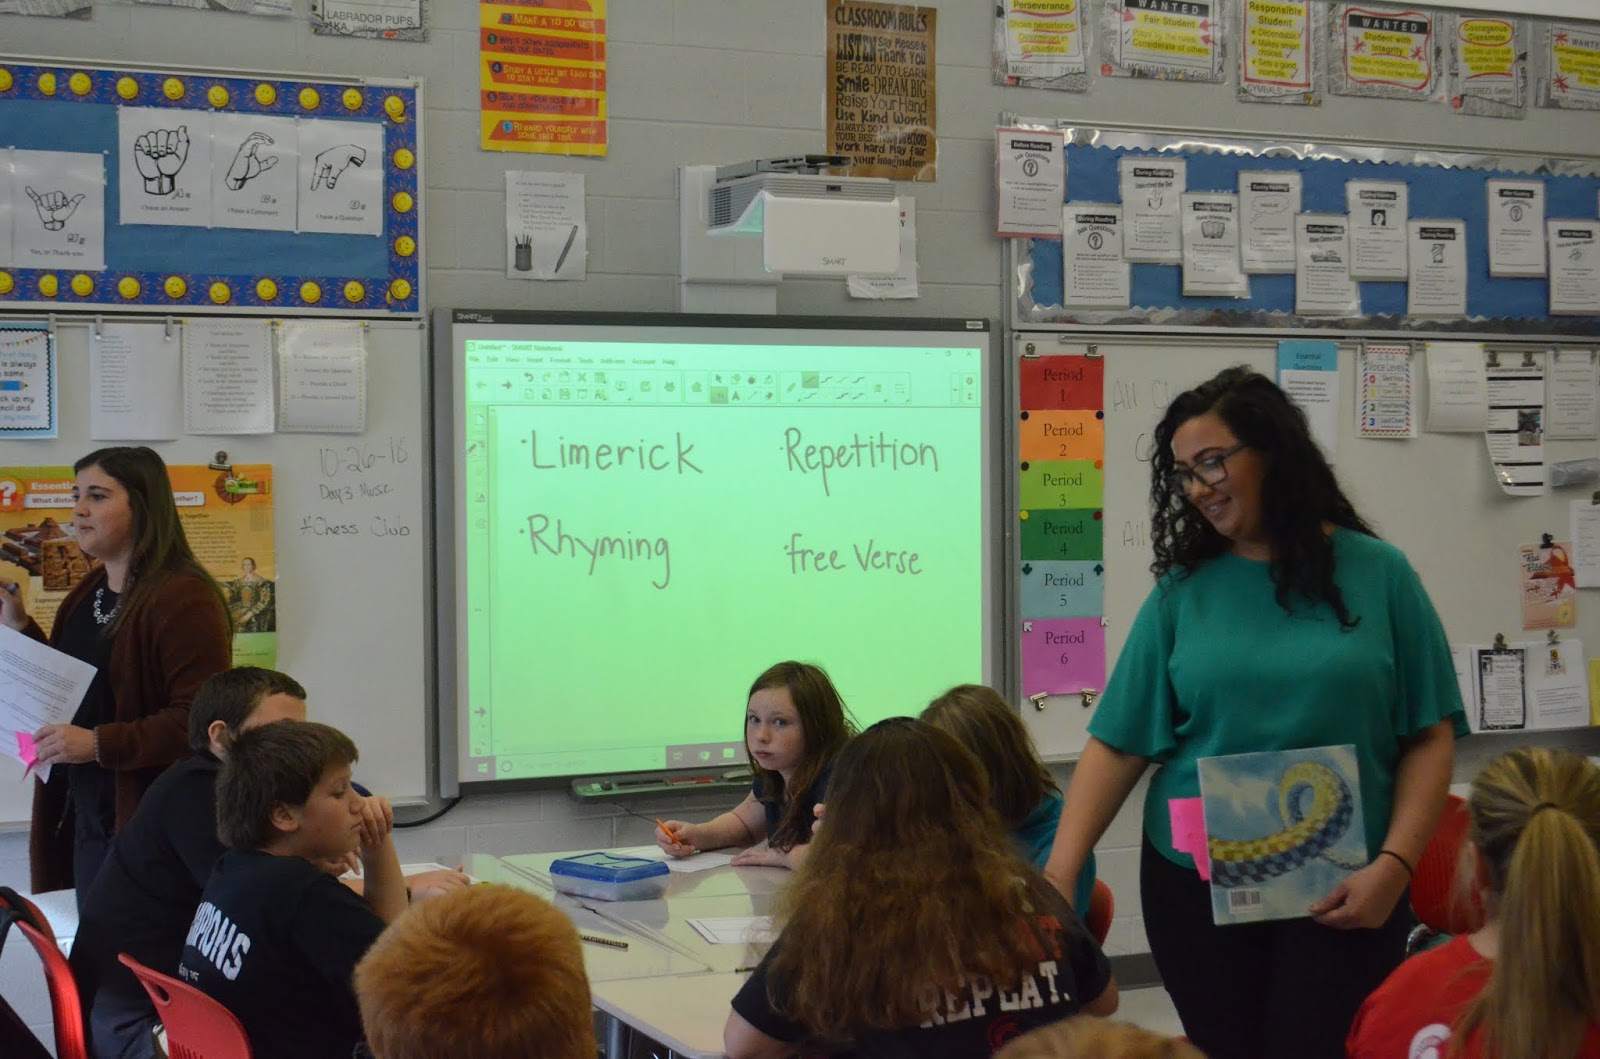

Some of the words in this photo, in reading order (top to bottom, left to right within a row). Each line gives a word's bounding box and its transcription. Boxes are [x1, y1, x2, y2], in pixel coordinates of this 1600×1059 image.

[1013, 1, 1070, 10] Perseverance
[1138, 0, 1200, 15] WANTED
[1249, 2, 1303, 16] Responsible
[326, 10, 383, 24] LABRADOR
[385, 15, 415, 26] PUPS,
[835, 6, 897, 30] CLASSROOM
[899, 13, 928, 33] RULES
[1144, 15, 1160, 23] Fair
[1162, 17, 1196, 28] Student
[1258, 16, 1292, 27] Student
[1361, 18, 1418, 32] WANTED
[1132, 38, 1179, 51] Considerate
[1363, 32, 1393, 42] Student
[1395, 35, 1412, 44] with
[1571, 38, 1600, 50] WANTE
[836, 33, 877, 64] LISTEN
[878, 36, 892, 49] Say
[895, 38, 920, 50] Please
[1371, 44, 1403, 56] Integrity
[878, 49, 907, 63] Thank
[910, 51, 926, 65] You
[836, 61, 849, 72] BE
[851, 62, 882, 75] READY
[884, 65, 897, 76] TO
[897, 67, 927, 79] LEARN
[836, 74, 870, 93] Smile
[874, 77, 909, 97] DREAM
[911, 79, 927, 99] BIG
[836, 93, 869, 108] Raise
[870, 95, 898, 111] Your
[899, 98, 927, 113] Hand
[836, 108, 855, 122] Use
[861, 109, 888, 124] Kind
[893, 112, 927, 126] Words
[835, 122, 866, 133] ALWAYS
[868, 124, 878, 133] DO
[835, 132, 856, 141] YOUR
[836, 142, 860, 152] Work
[863, 143, 885, 153] hard
[889, 145, 906, 156] Play
[909, 146, 927, 157] fair
[853, 156, 875, 167] your
[877, 155, 926, 168] imagination
[1024, 151, 1051, 164] Questions
[1077, 226, 1087, 235] Ask
[1088, 224, 1116, 236] Questions
[822, 257, 847, 266] SMART
[10, 361, 37, 370] always
[1044, 368, 1083, 382] Period
[1060, 389, 1066, 402] 1
[1370, 403, 1376, 412] 2
[1369, 417, 1376, 426] 3
[1044, 423, 1083, 437] Period
[532, 430, 703, 474] Limerick
[1059, 445, 1067, 457] 2
[784, 427, 939, 496] Repetition
[1043, 473, 1082, 487] Period
[1059, 494, 1066, 507] 3
[1044, 521, 1083, 535] Period
[526, 513, 671, 589] Rhyming
[1059, 543, 1068, 555] 4
[853, 538, 922, 575] Verse
[1044, 574, 1084, 587] Period
[1060, 594, 1067, 607] 5
[1045, 631, 1085, 645] Period
[1061, 653, 1068, 665] 6
